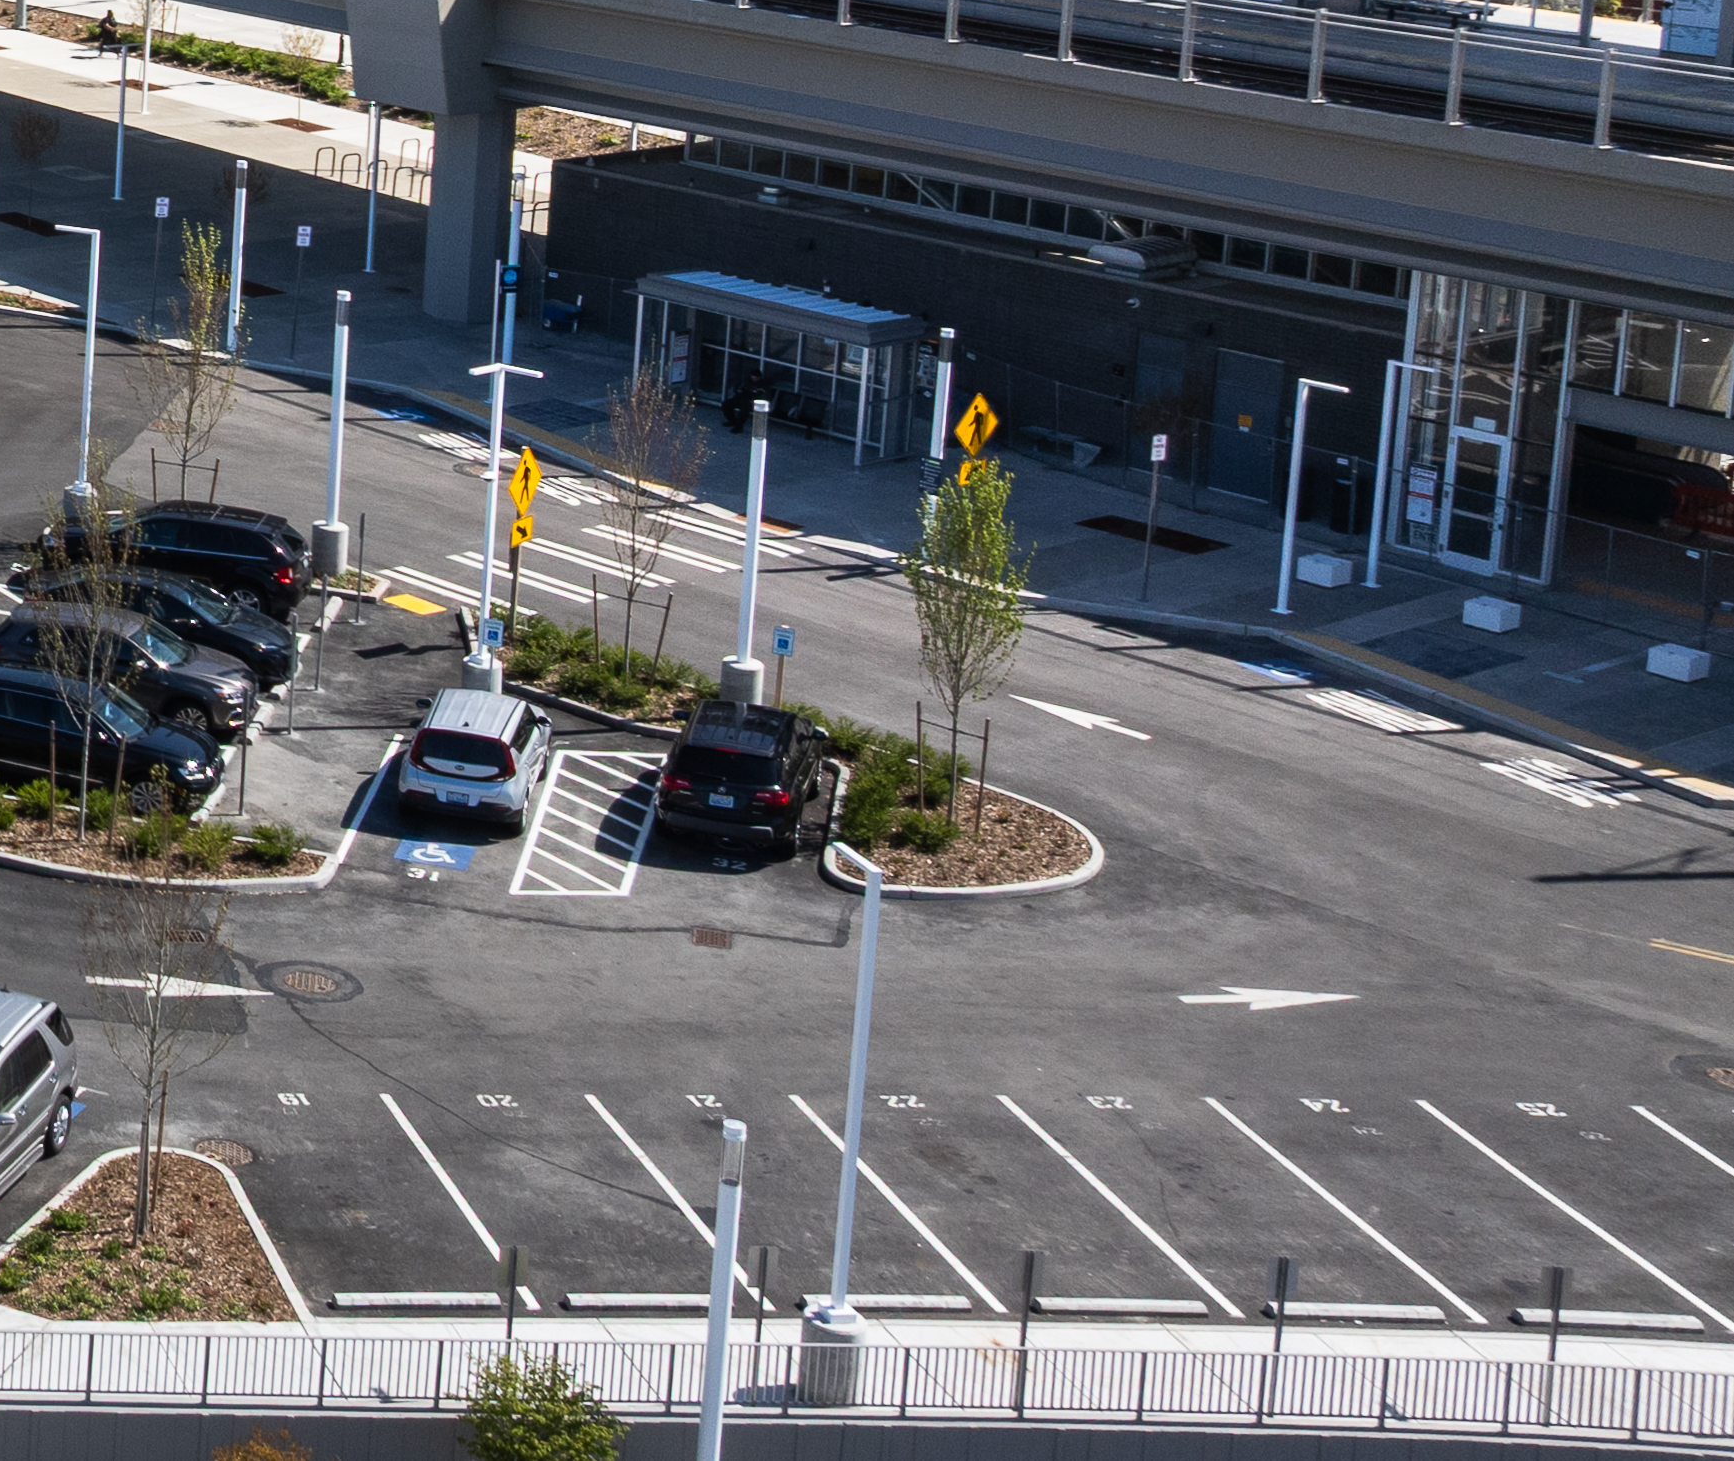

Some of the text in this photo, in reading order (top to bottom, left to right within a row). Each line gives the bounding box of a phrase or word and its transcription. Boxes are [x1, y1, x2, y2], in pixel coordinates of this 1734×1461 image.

[712, 857, 748, 870] 32
[407, 867, 440, 882] 31
[277, 1093, 311, 1106] 19
[476, 1094, 519, 1107] 20
[685, 1094, 723, 1108] 21
[879, 1095, 926, 1108] 22
[1086, 1096, 1133, 1109] 23
[1299, 1098, 1351, 1113] 24
[1516, 1102, 1568, 1117] 25
